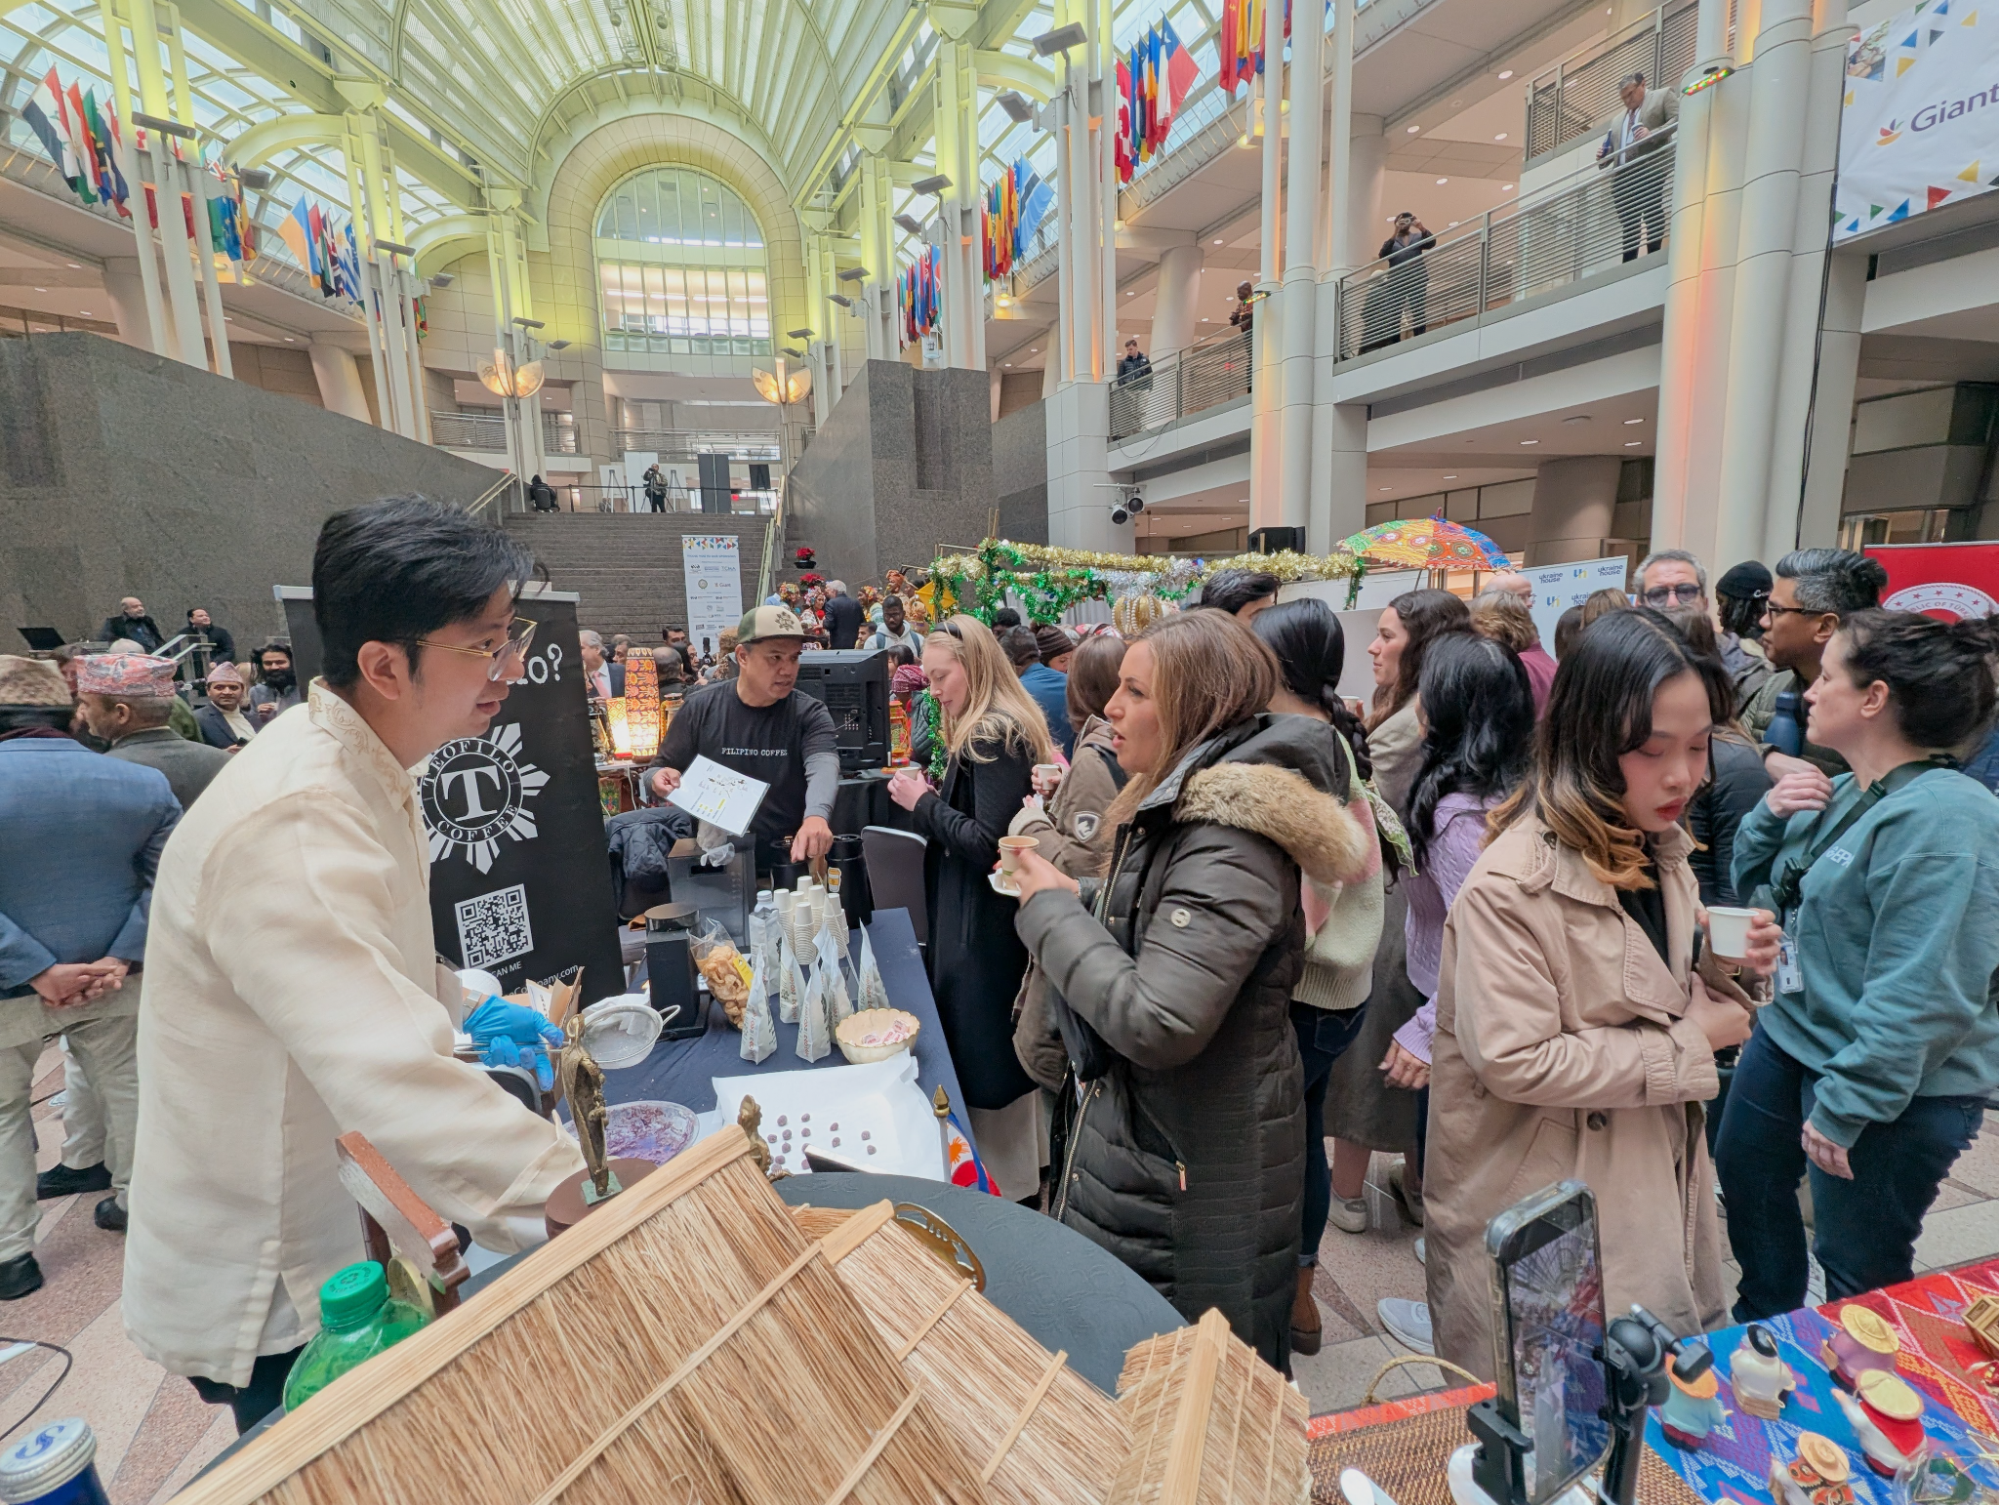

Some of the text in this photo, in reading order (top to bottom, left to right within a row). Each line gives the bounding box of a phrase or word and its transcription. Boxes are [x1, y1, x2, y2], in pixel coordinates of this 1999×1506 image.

[1911, 83, 1999, 132] Giant
[1597, 564, 1623, 573] ukraine
[1539, 572, 1563, 580] ukraine
[1571, 592, 1591, 601] ukrai
[721, 747, 759, 756] FILIPINO
[423, 740, 515, 787] TEOFILO
[440, 765, 501, 822] T
[437, 804, 518, 841] COFFEE
[509, 960, 522, 972] ME
